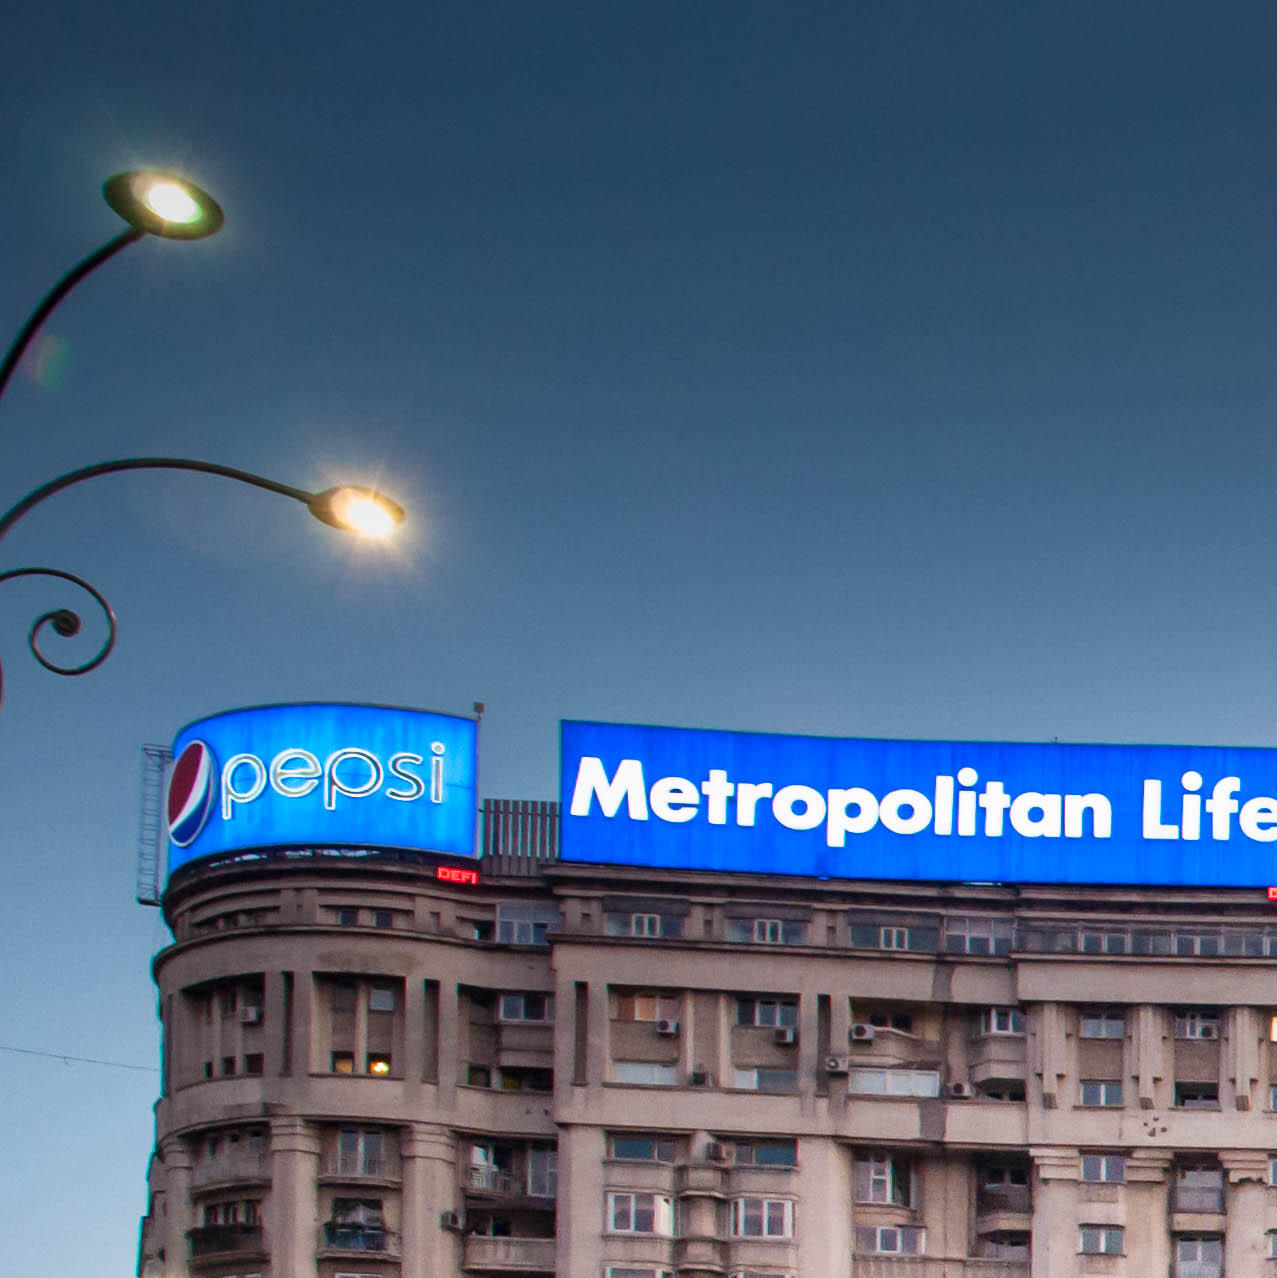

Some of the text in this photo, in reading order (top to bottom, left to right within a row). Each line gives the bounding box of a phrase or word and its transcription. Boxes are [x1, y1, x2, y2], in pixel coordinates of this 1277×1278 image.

[221, 742, 445, 821] pepsi
[570, 756, 1112, 848] Metropolitan
[438, 867, 477, 883] DEFI
